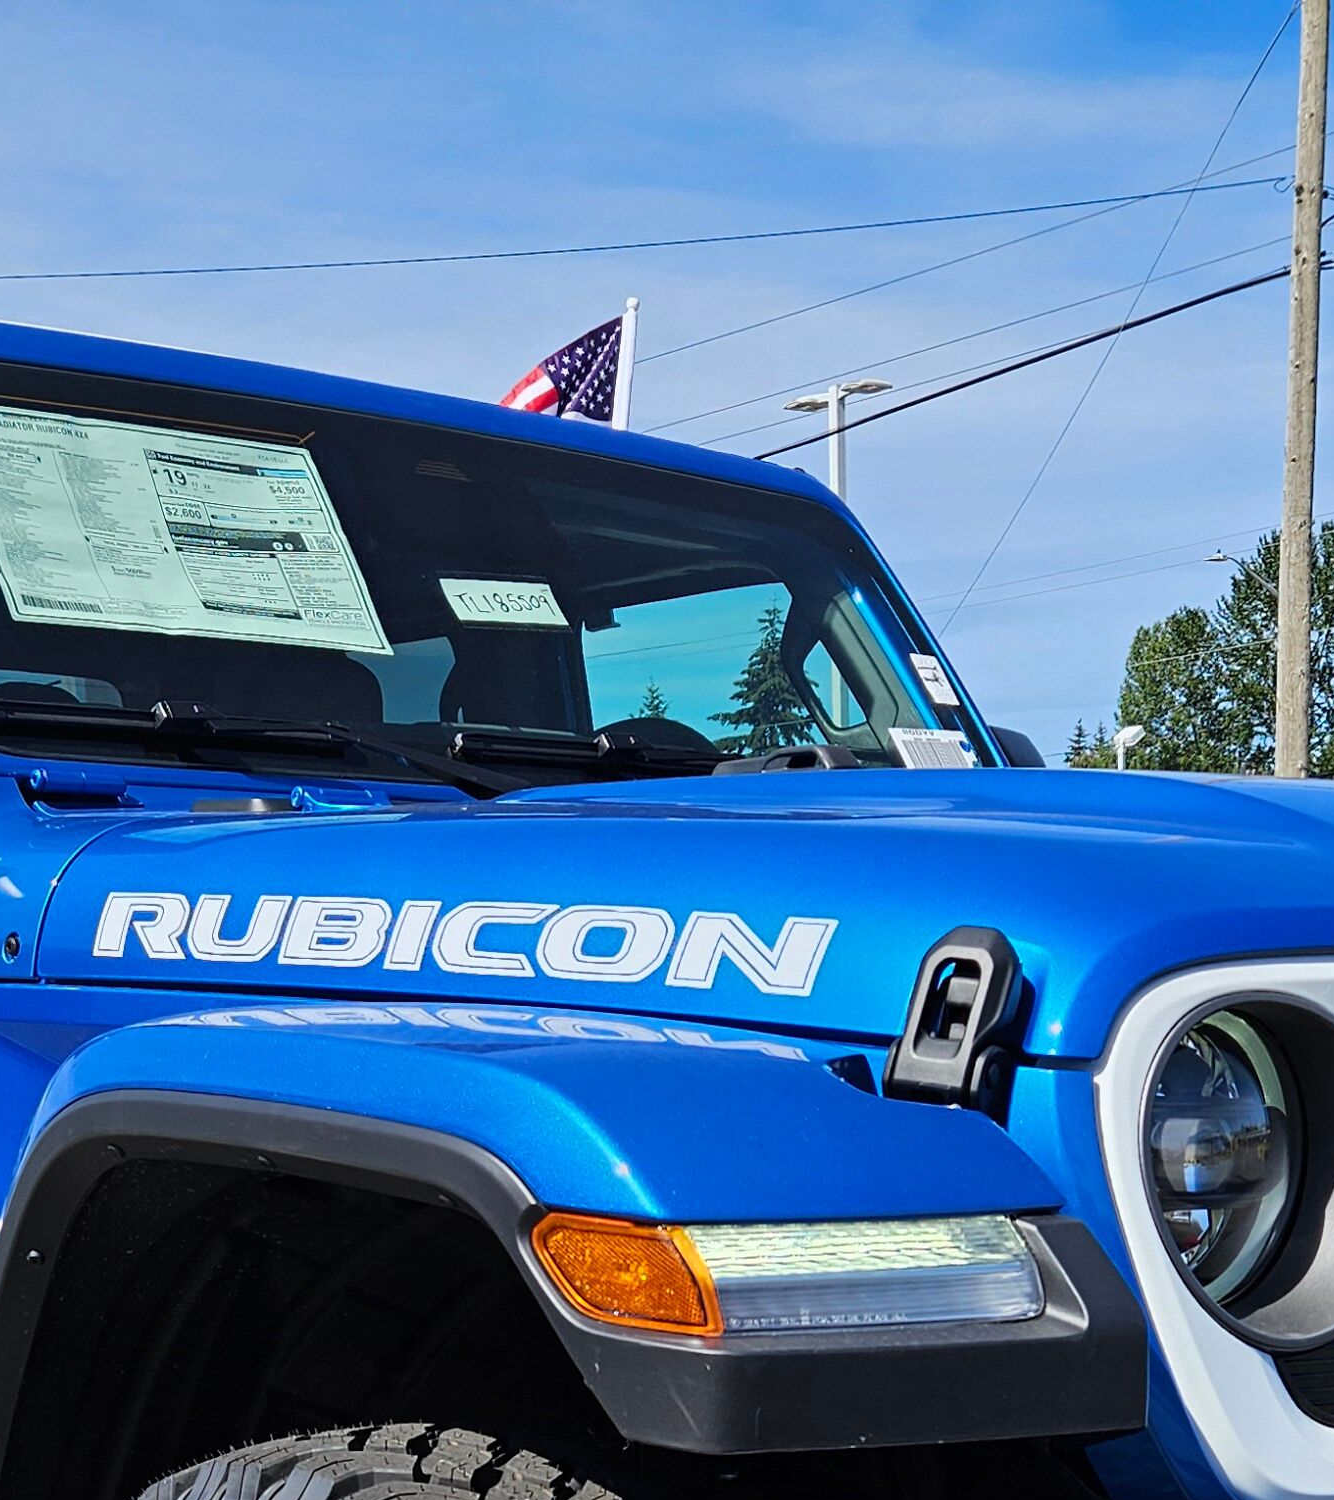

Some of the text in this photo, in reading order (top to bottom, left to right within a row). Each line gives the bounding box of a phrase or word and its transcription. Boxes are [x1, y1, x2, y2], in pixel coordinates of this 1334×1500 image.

[35, 424, 73, 438] RUBICON
[163, 468, 187, 486] 19
[269, 486, 305, 496] $4,500
[166, 506, 202, 520] $2,600
[304, 609, 363, 622] FlexCare
[92, 891, 838, 997] RUBICON
